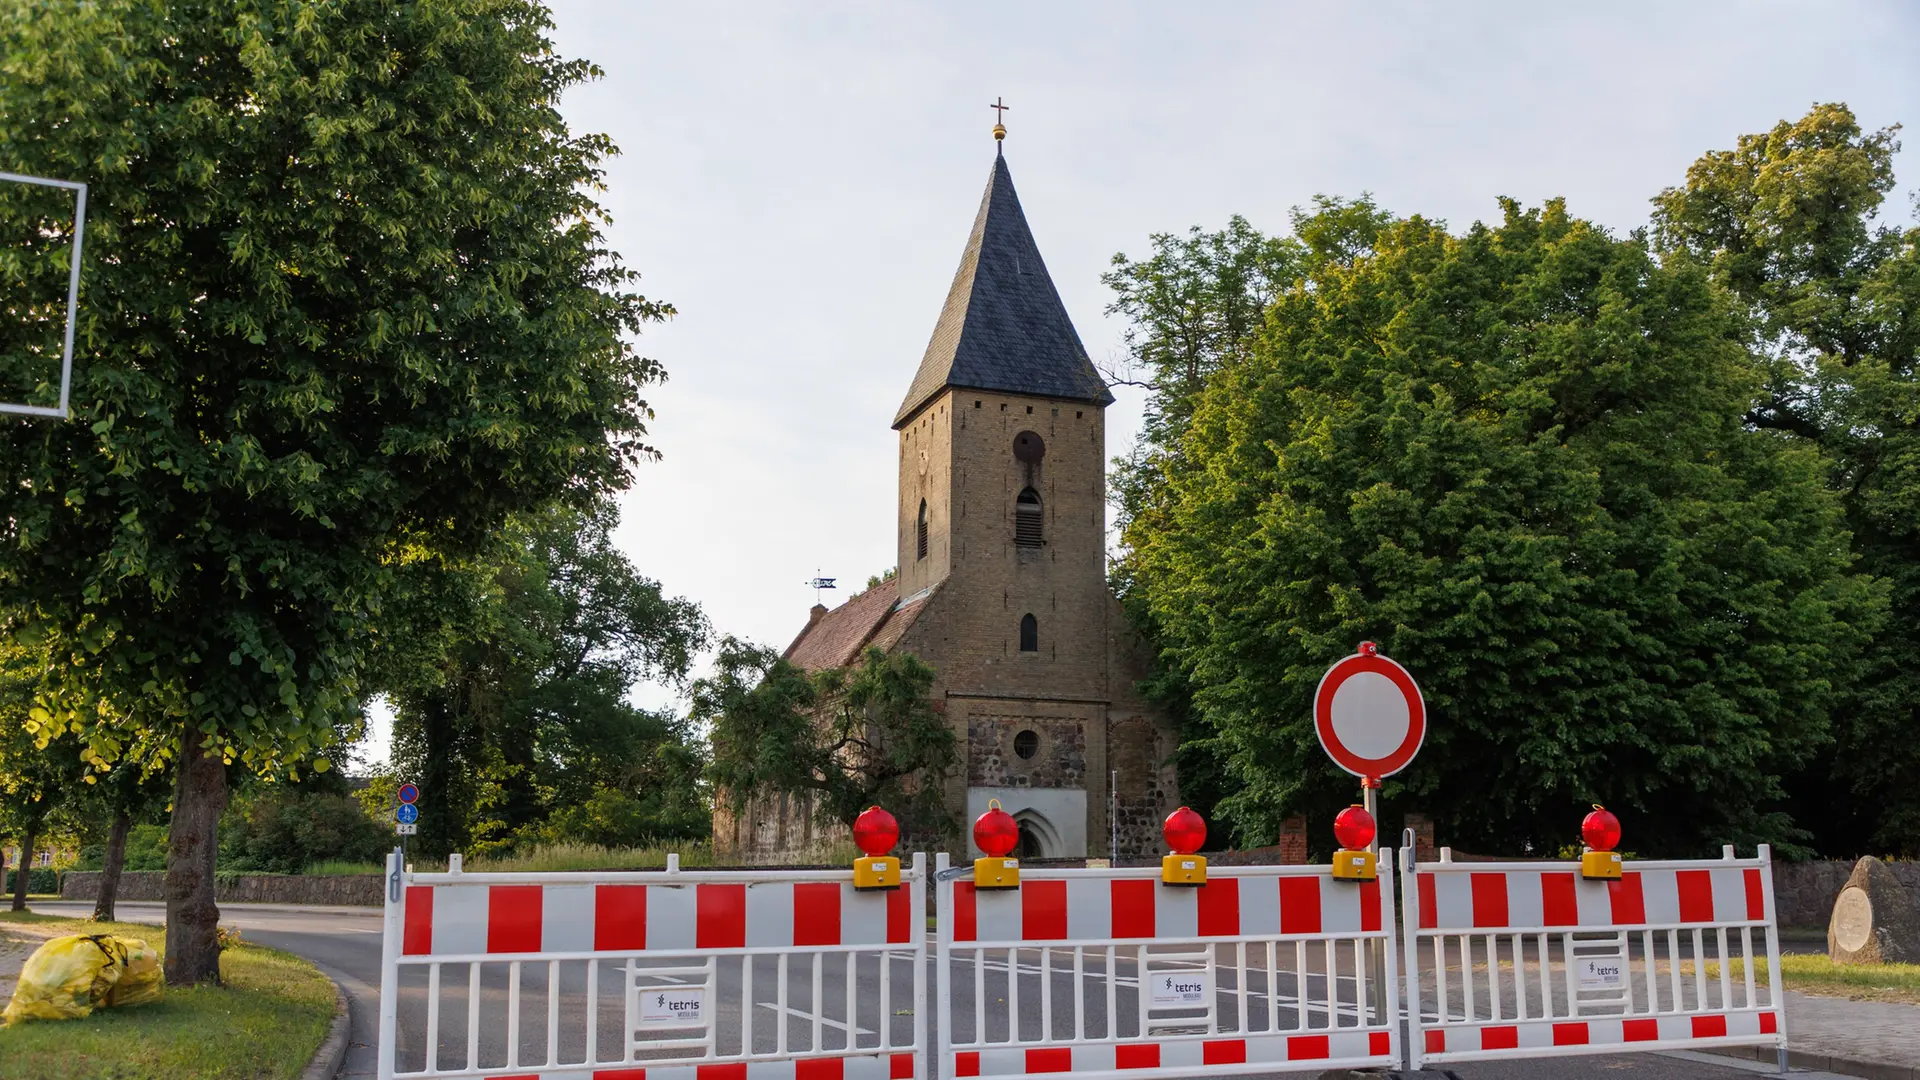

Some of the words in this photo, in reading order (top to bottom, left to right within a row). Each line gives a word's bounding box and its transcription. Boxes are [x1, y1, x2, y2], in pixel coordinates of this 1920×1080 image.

[1597, 966, 1619, 975] tetris
[1176, 983, 1202, 993] tetris
[668, 1000, 700, 1011] tetris
